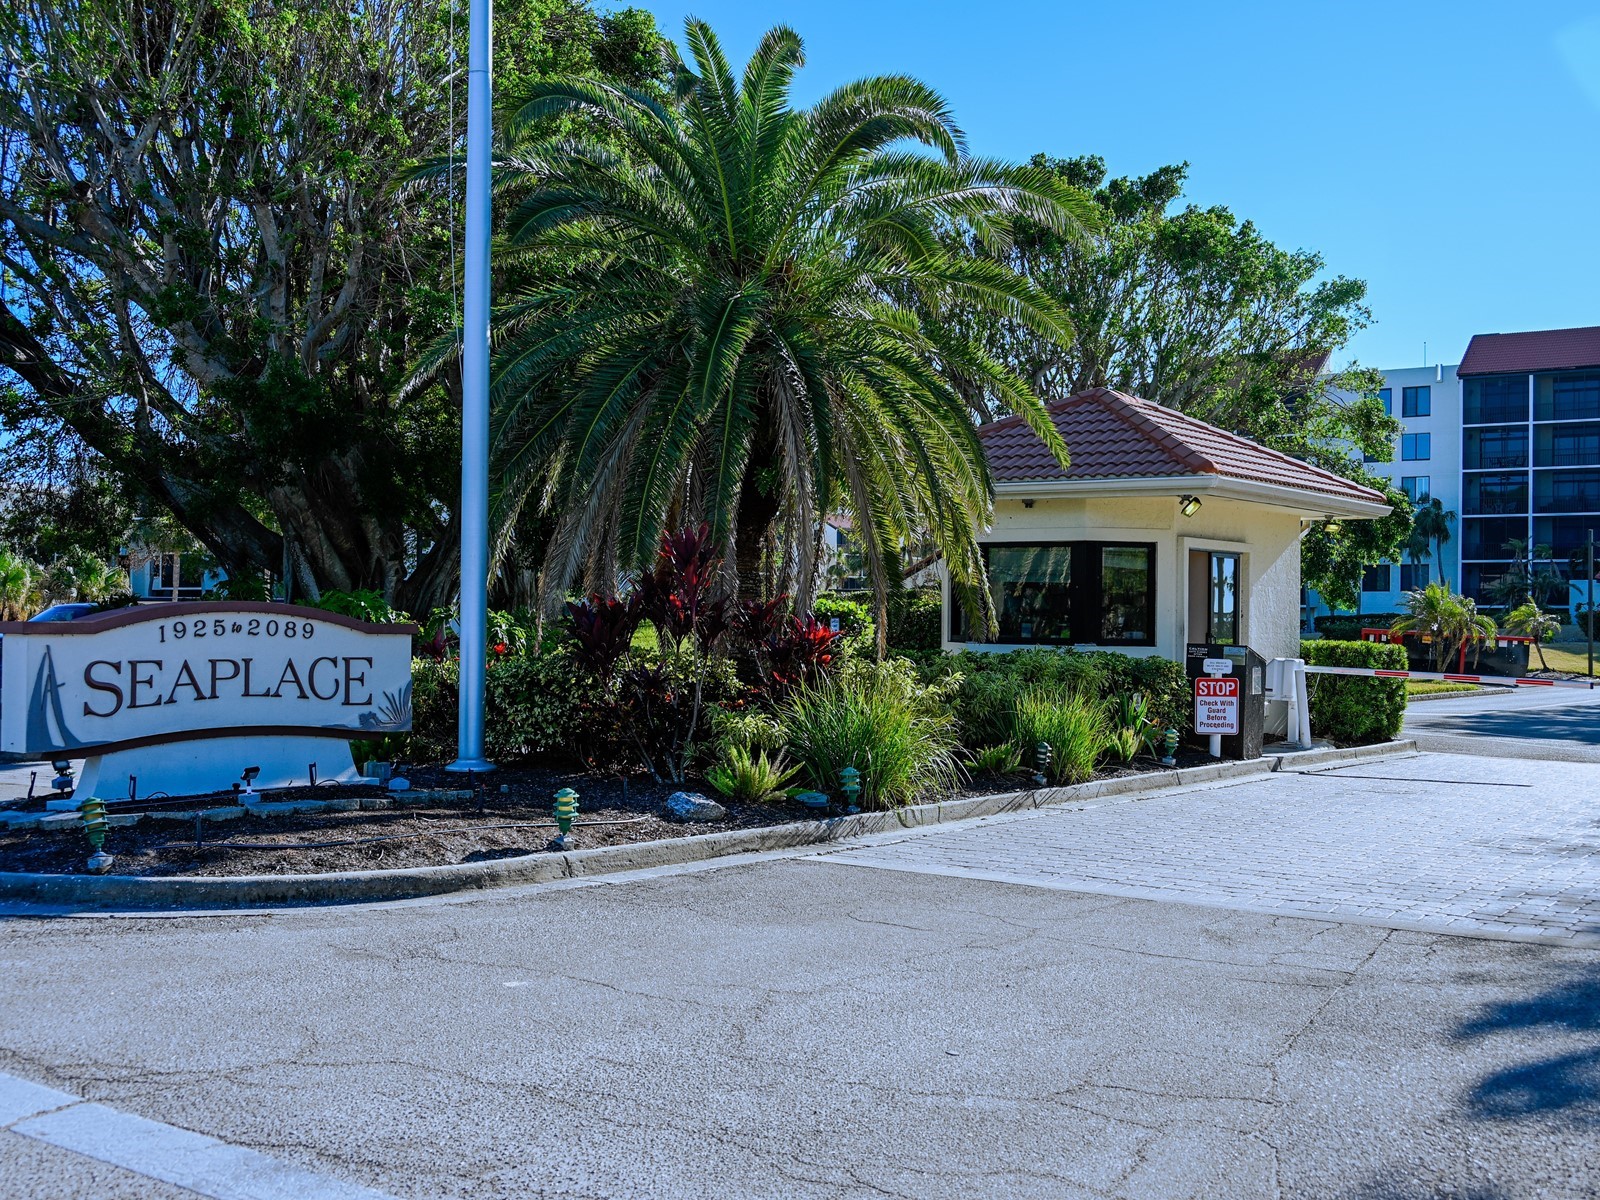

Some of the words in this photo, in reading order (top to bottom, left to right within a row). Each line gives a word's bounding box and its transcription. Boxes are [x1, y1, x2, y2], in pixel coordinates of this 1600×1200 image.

[158, 619, 226, 643] 1925
[231, 621, 243, 634] to
[247, 618, 315, 640] 2089
[83, 656, 374, 718] SEAPLACE
[1198, 681, 1236, 695] STOP
